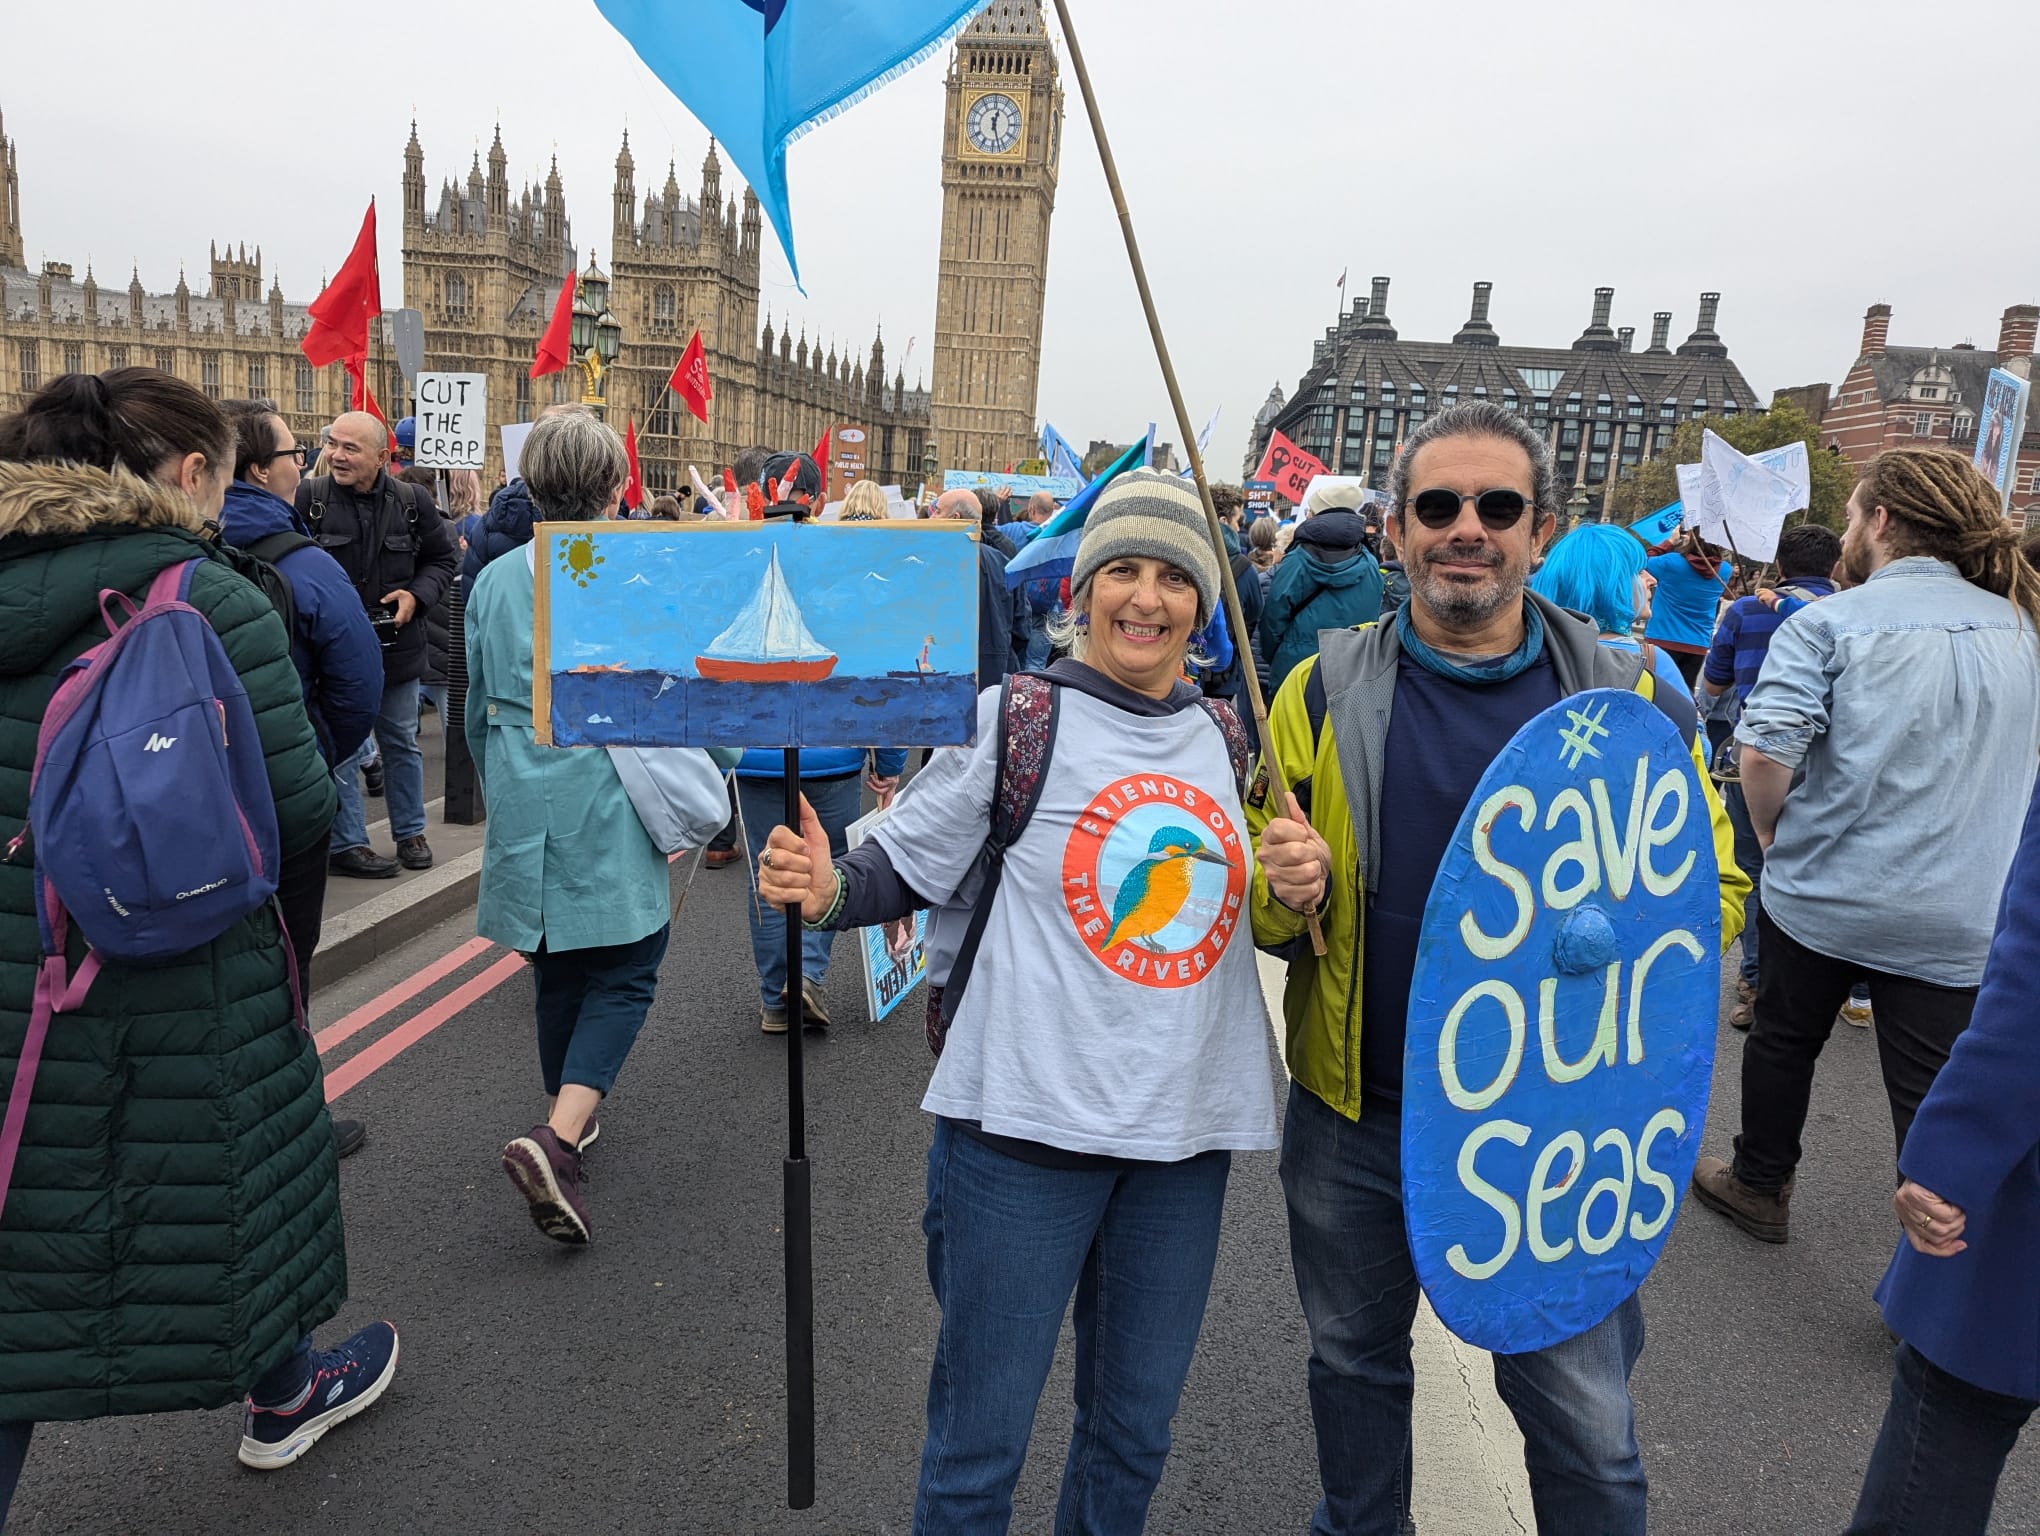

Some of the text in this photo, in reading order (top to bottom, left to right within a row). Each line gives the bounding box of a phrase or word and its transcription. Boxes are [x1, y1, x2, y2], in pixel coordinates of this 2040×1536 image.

[420, 378, 471, 407] CUT
[422, 412, 462, 434] THE
[420, 437, 479, 460] CRAP
[1293, 456, 1315, 474] CUT
[1247, 501, 1270, 509] SHOW!
[1082, 779, 1236, 848] FRIENDS OF
[175, 878, 228, 900] Quechua
[1069, 872, 1240, 980] THE RIVER EXE
